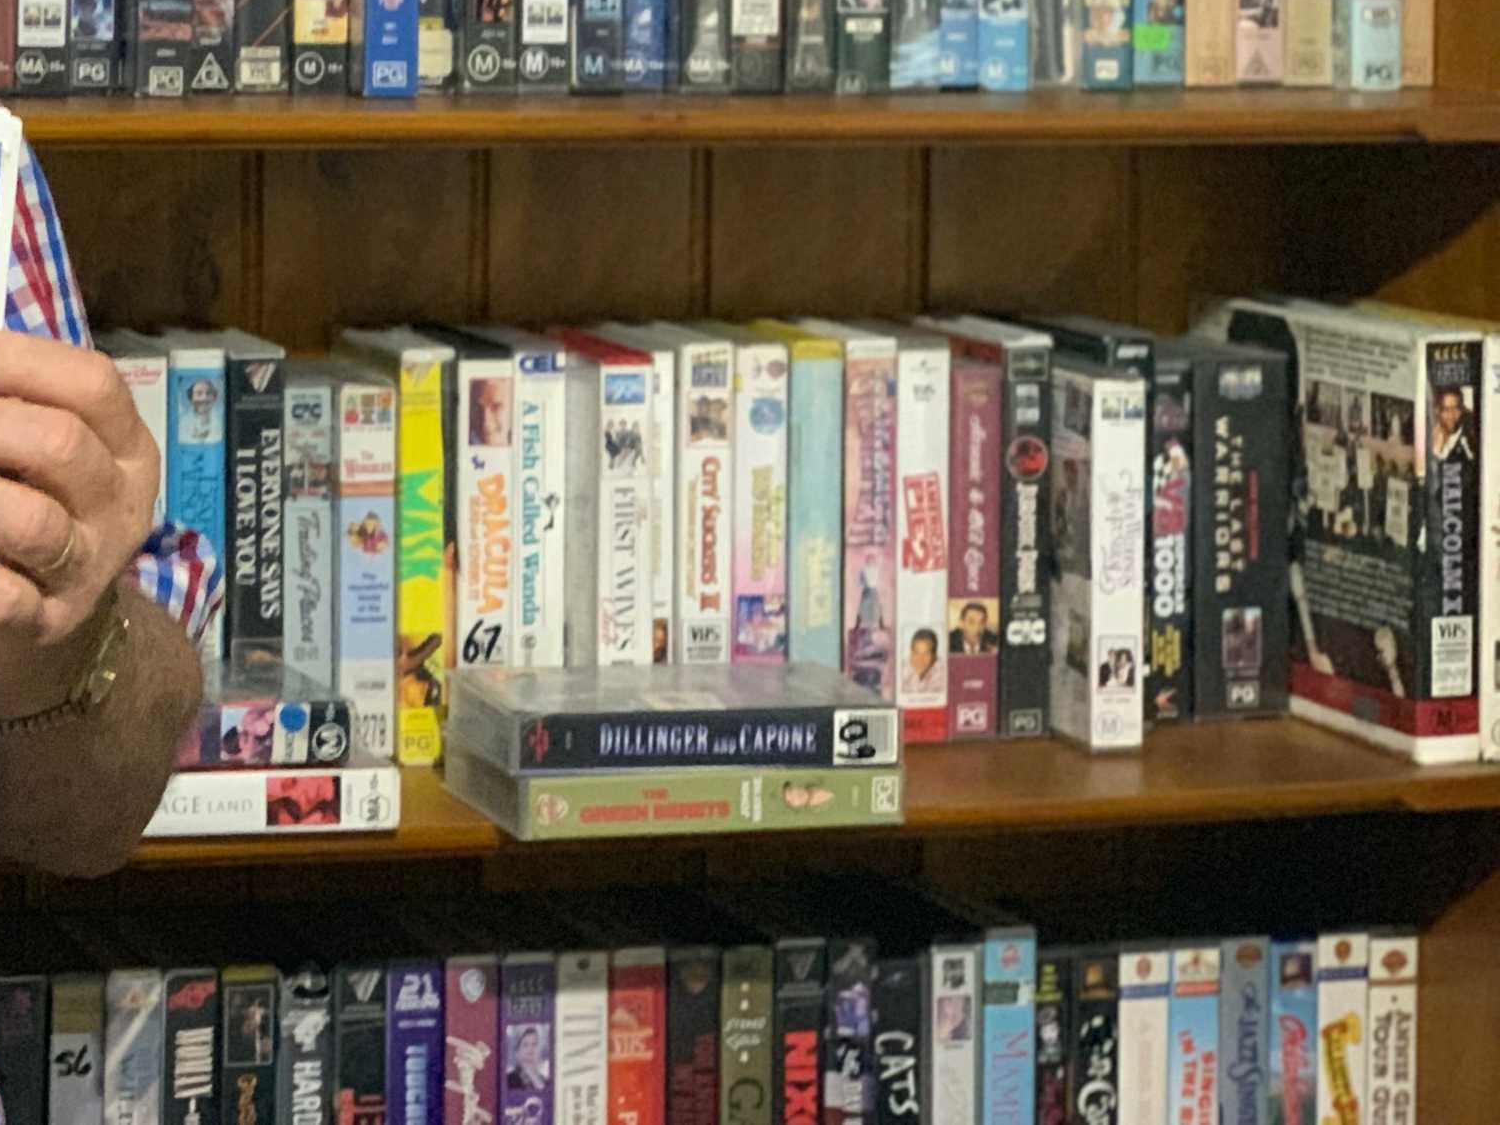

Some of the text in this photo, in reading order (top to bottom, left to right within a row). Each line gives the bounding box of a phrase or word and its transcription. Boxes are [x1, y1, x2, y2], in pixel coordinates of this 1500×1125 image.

[236, 460, 255, 527] LOVE
[260, 427, 280, 559] EVERYONE
[400, 469, 443, 582] MASK
[476, 473, 511, 615] DRACULA
[521, 401, 540, 626] A Fish Called Wanda
[614, 486, 636, 557] FIRST
[1215, 415, 1230, 593] WARRIORS
[1441, 461, 1463, 615] MALCOLM X
[237, 533, 255, 586] YOU
[1154, 535, 1174, 617] 1000
[600, 722, 709, 755] DILLINGER
[739, 722, 817, 753] CAPONE
